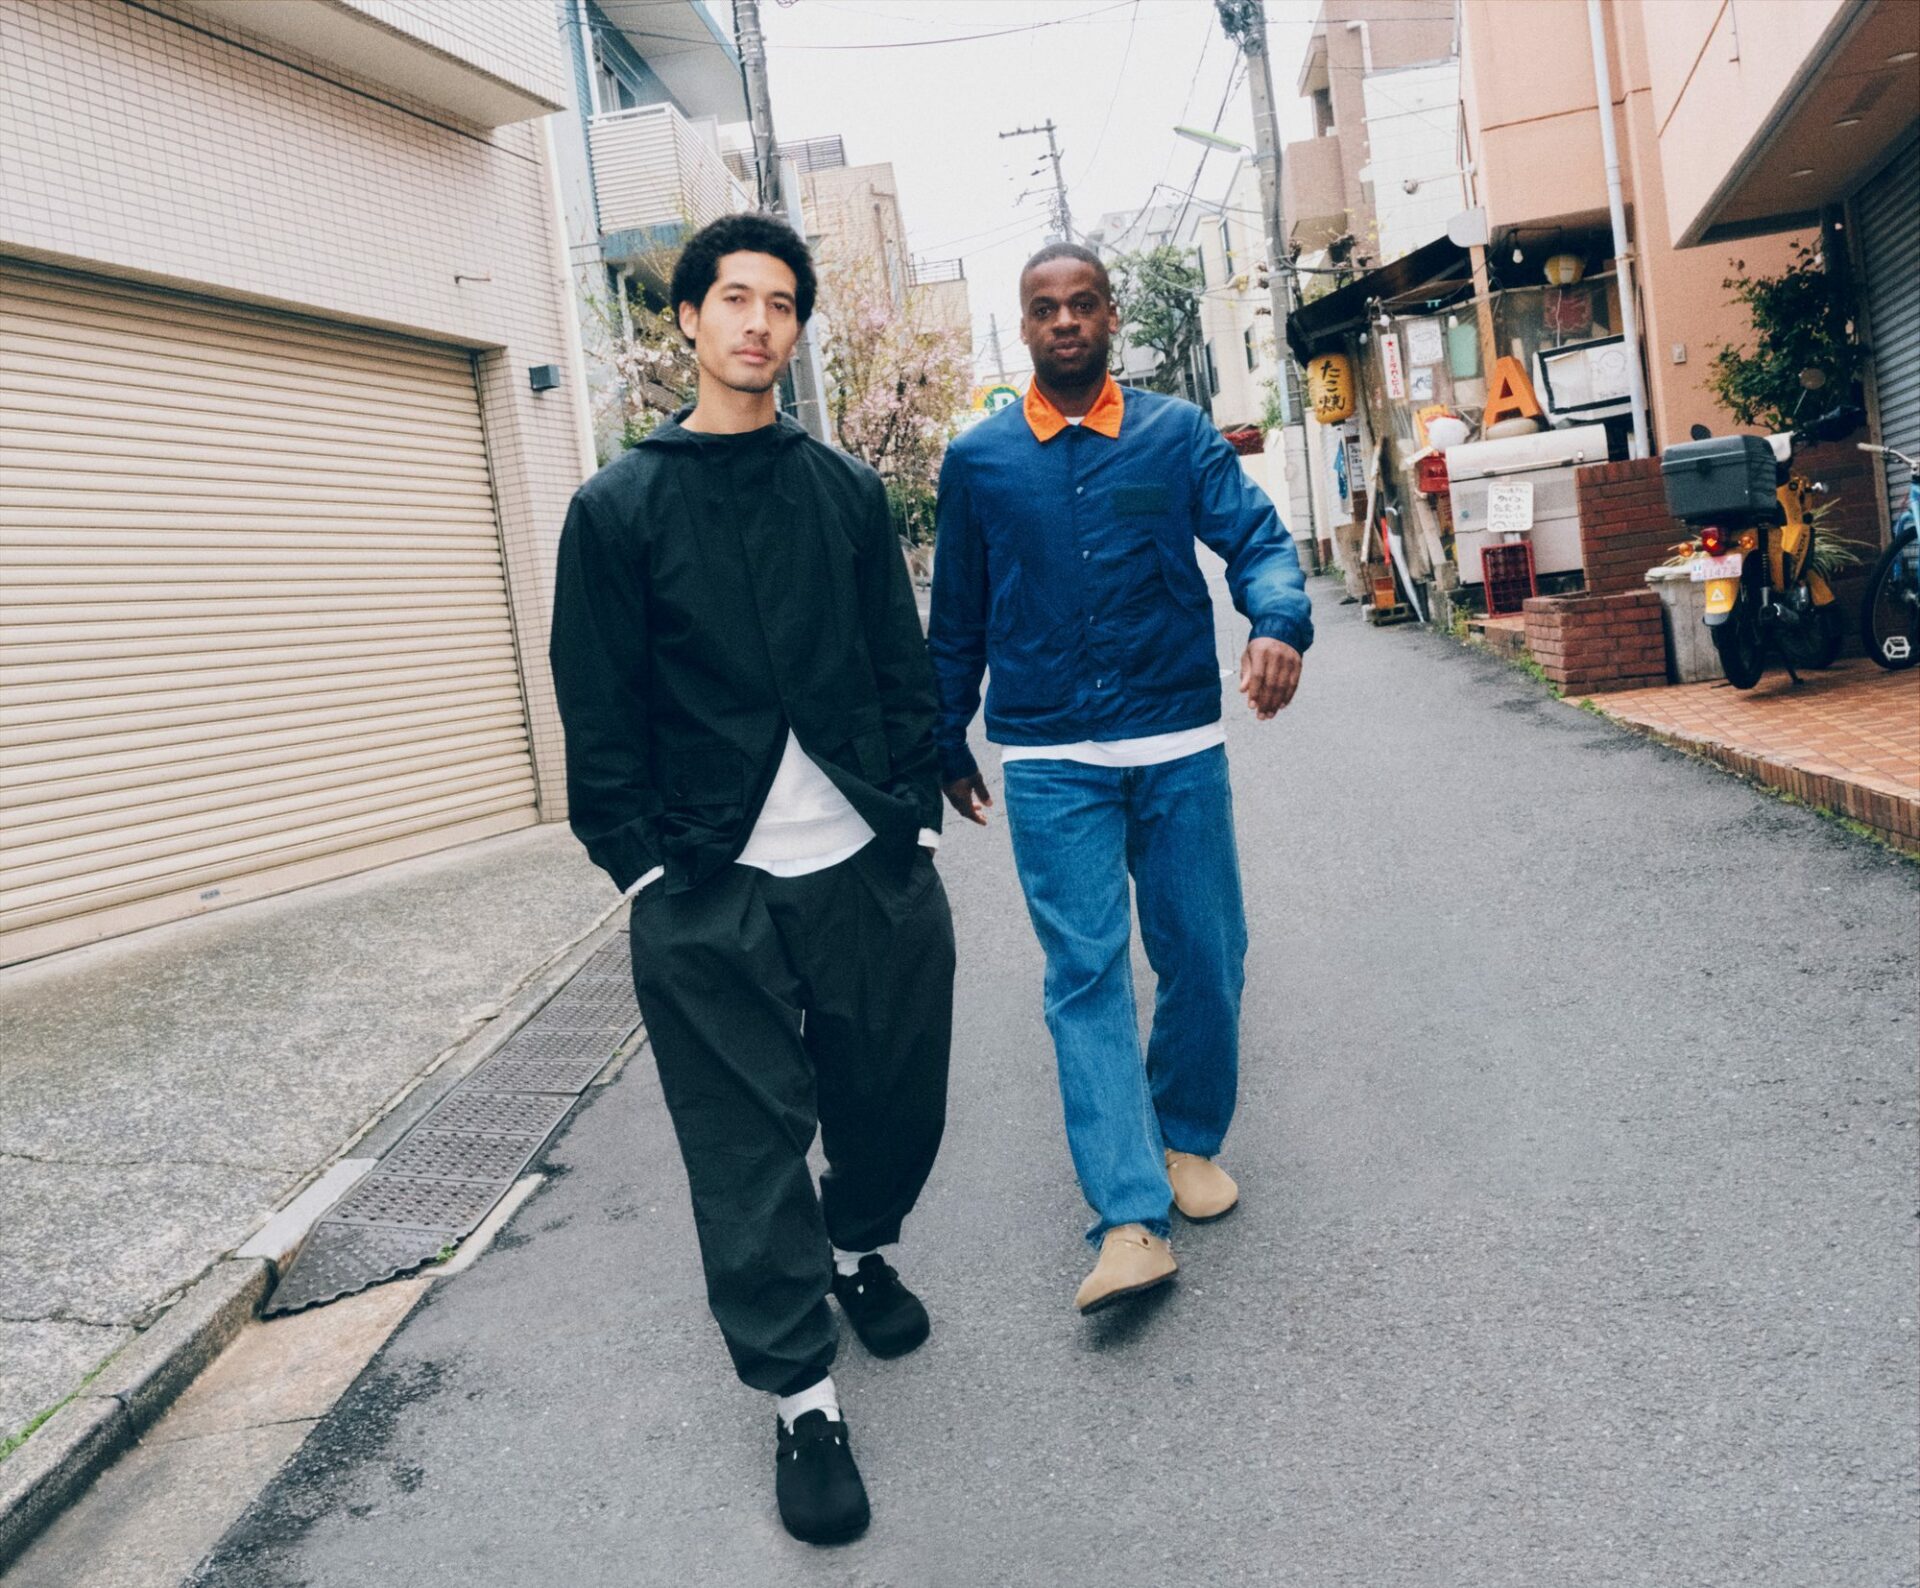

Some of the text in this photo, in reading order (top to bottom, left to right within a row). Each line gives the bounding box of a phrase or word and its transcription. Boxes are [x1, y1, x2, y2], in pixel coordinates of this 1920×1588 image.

[1319, 360, 1346, 415] たこ焼
[1483, 356, 1541, 428] A
